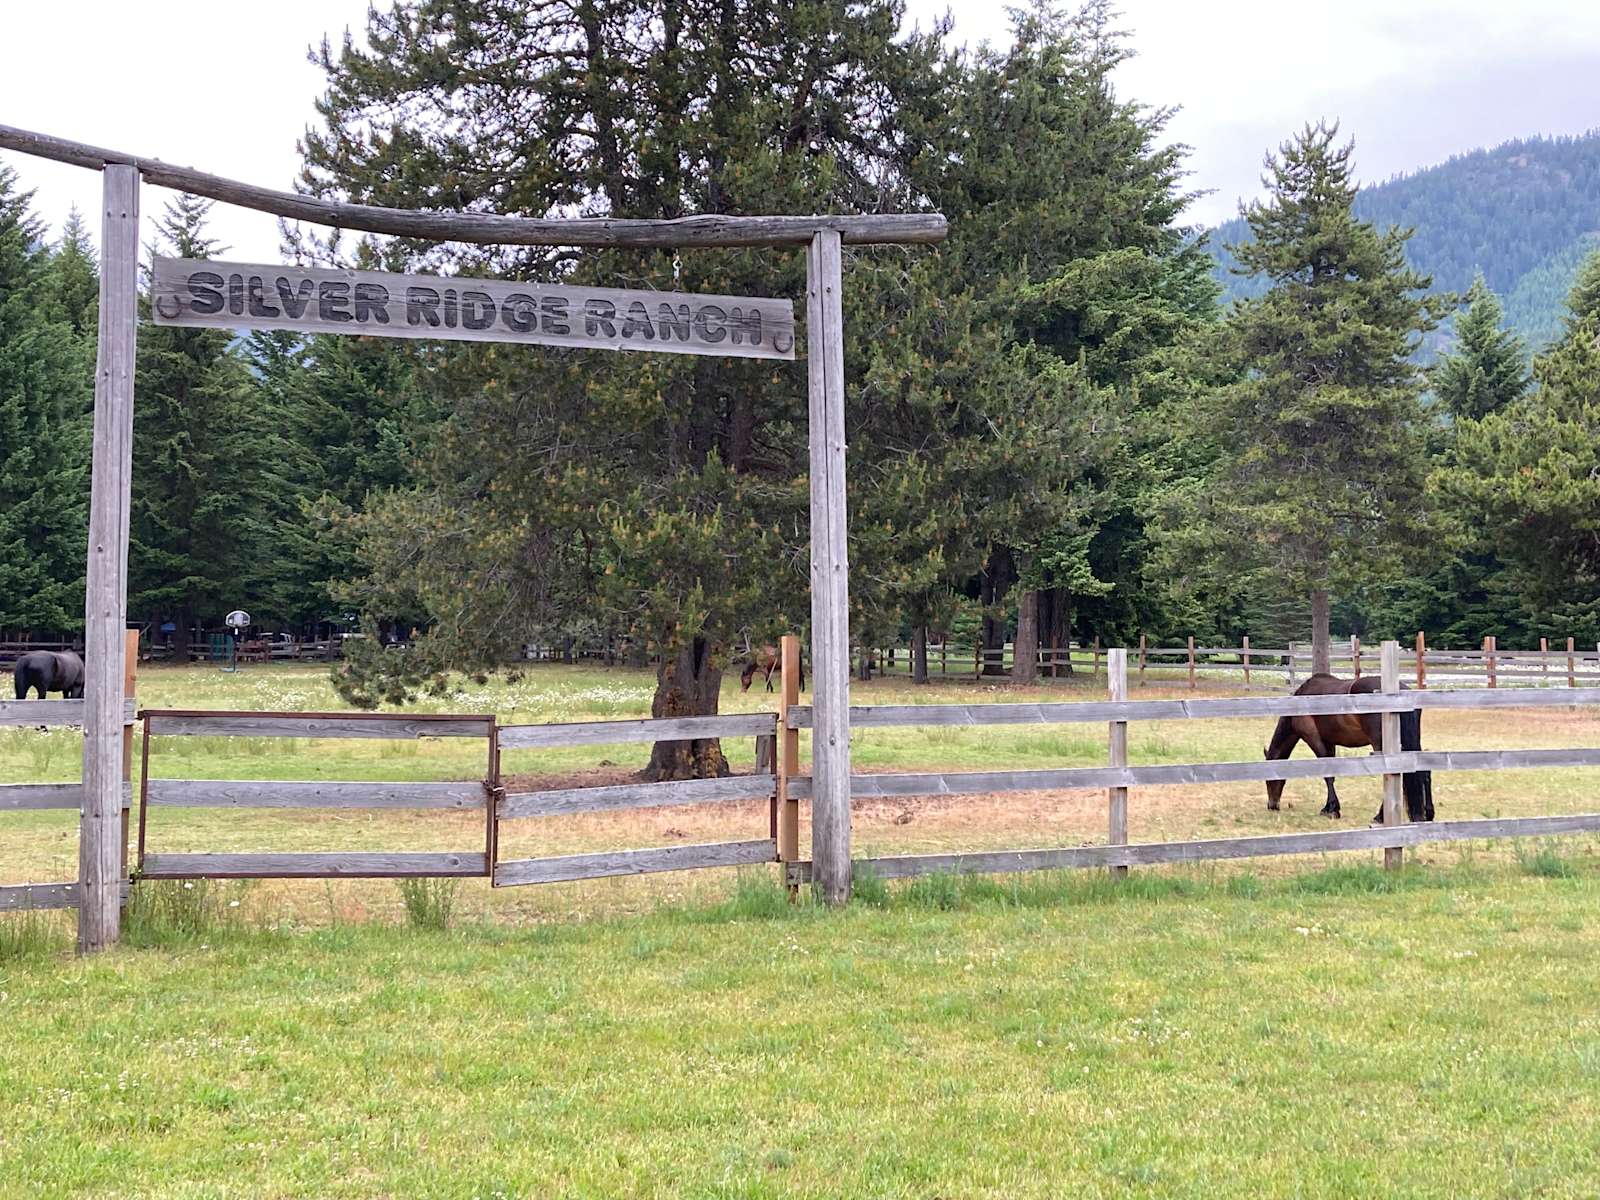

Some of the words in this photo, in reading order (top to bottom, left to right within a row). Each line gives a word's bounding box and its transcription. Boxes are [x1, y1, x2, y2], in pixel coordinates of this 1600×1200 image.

[187, 271, 390, 324] SILVER
[405, 286, 570, 335] RIDGE
[584, 299, 762, 346] RANCH
